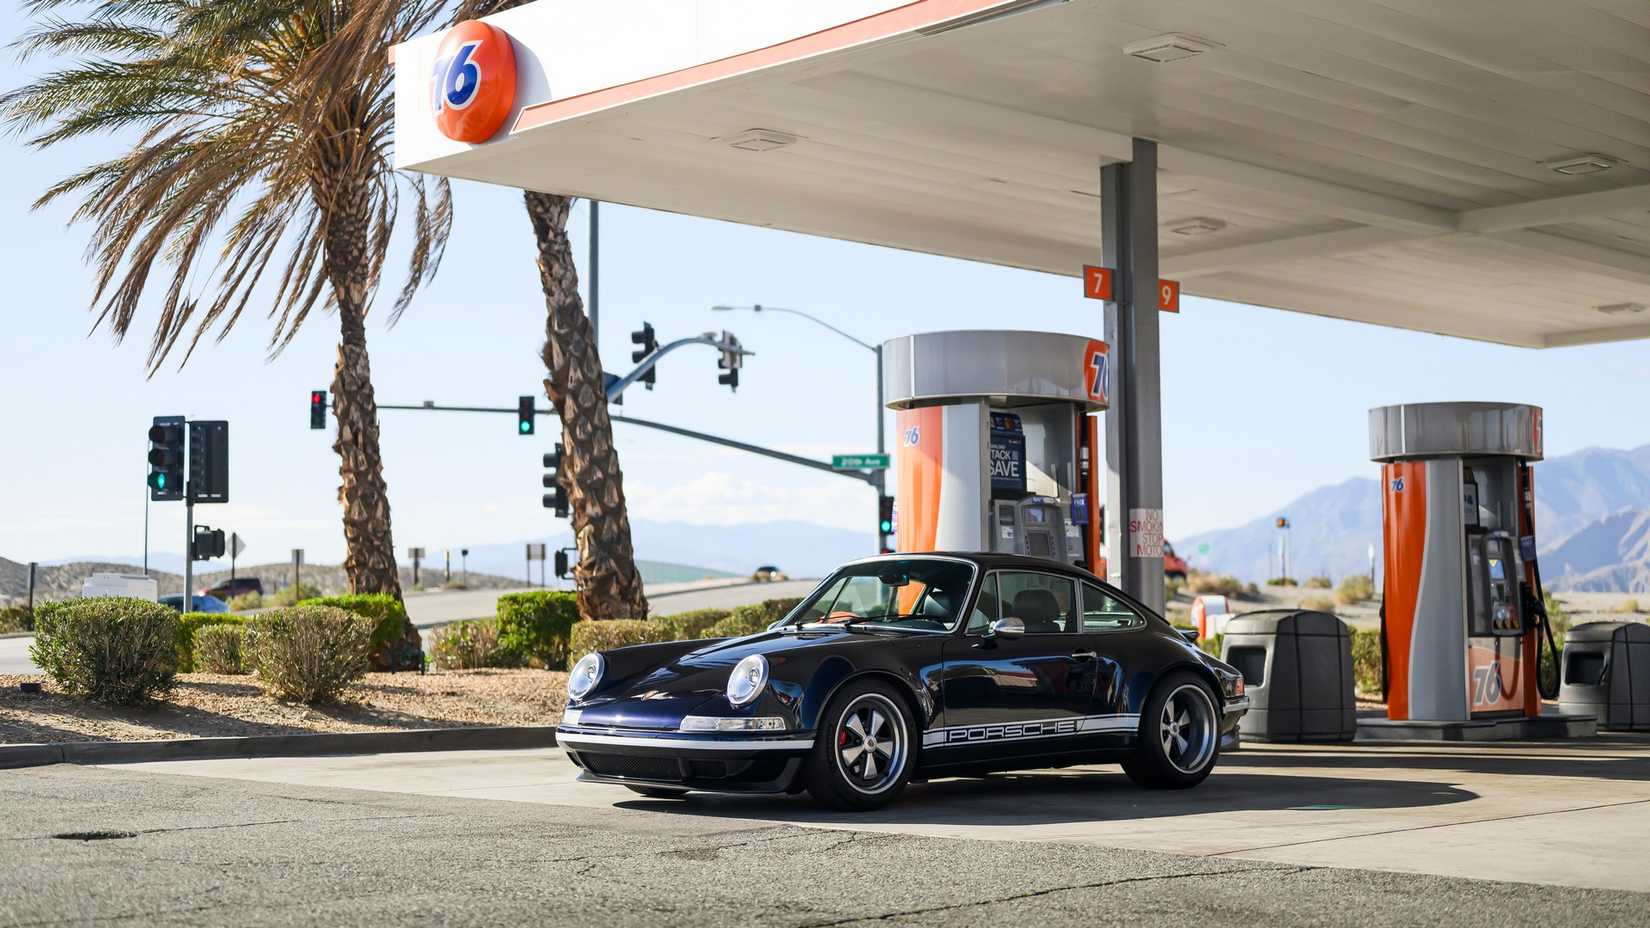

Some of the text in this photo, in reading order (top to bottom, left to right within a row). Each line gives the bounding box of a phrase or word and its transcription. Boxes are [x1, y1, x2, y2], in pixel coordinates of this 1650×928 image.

[1093, 272, 1103, 293] 7
[1162, 285, 1172, 305] 9
[904, 426, 920, 446] 76
[864, 457, 881, 465] Ave
[990, 449, 1010, 460] TACK
[1391, 477, 1405, 492] 76
[1473, 661, 1501, 705] 76
[949, 720, 1075, 742] PORSCHE
